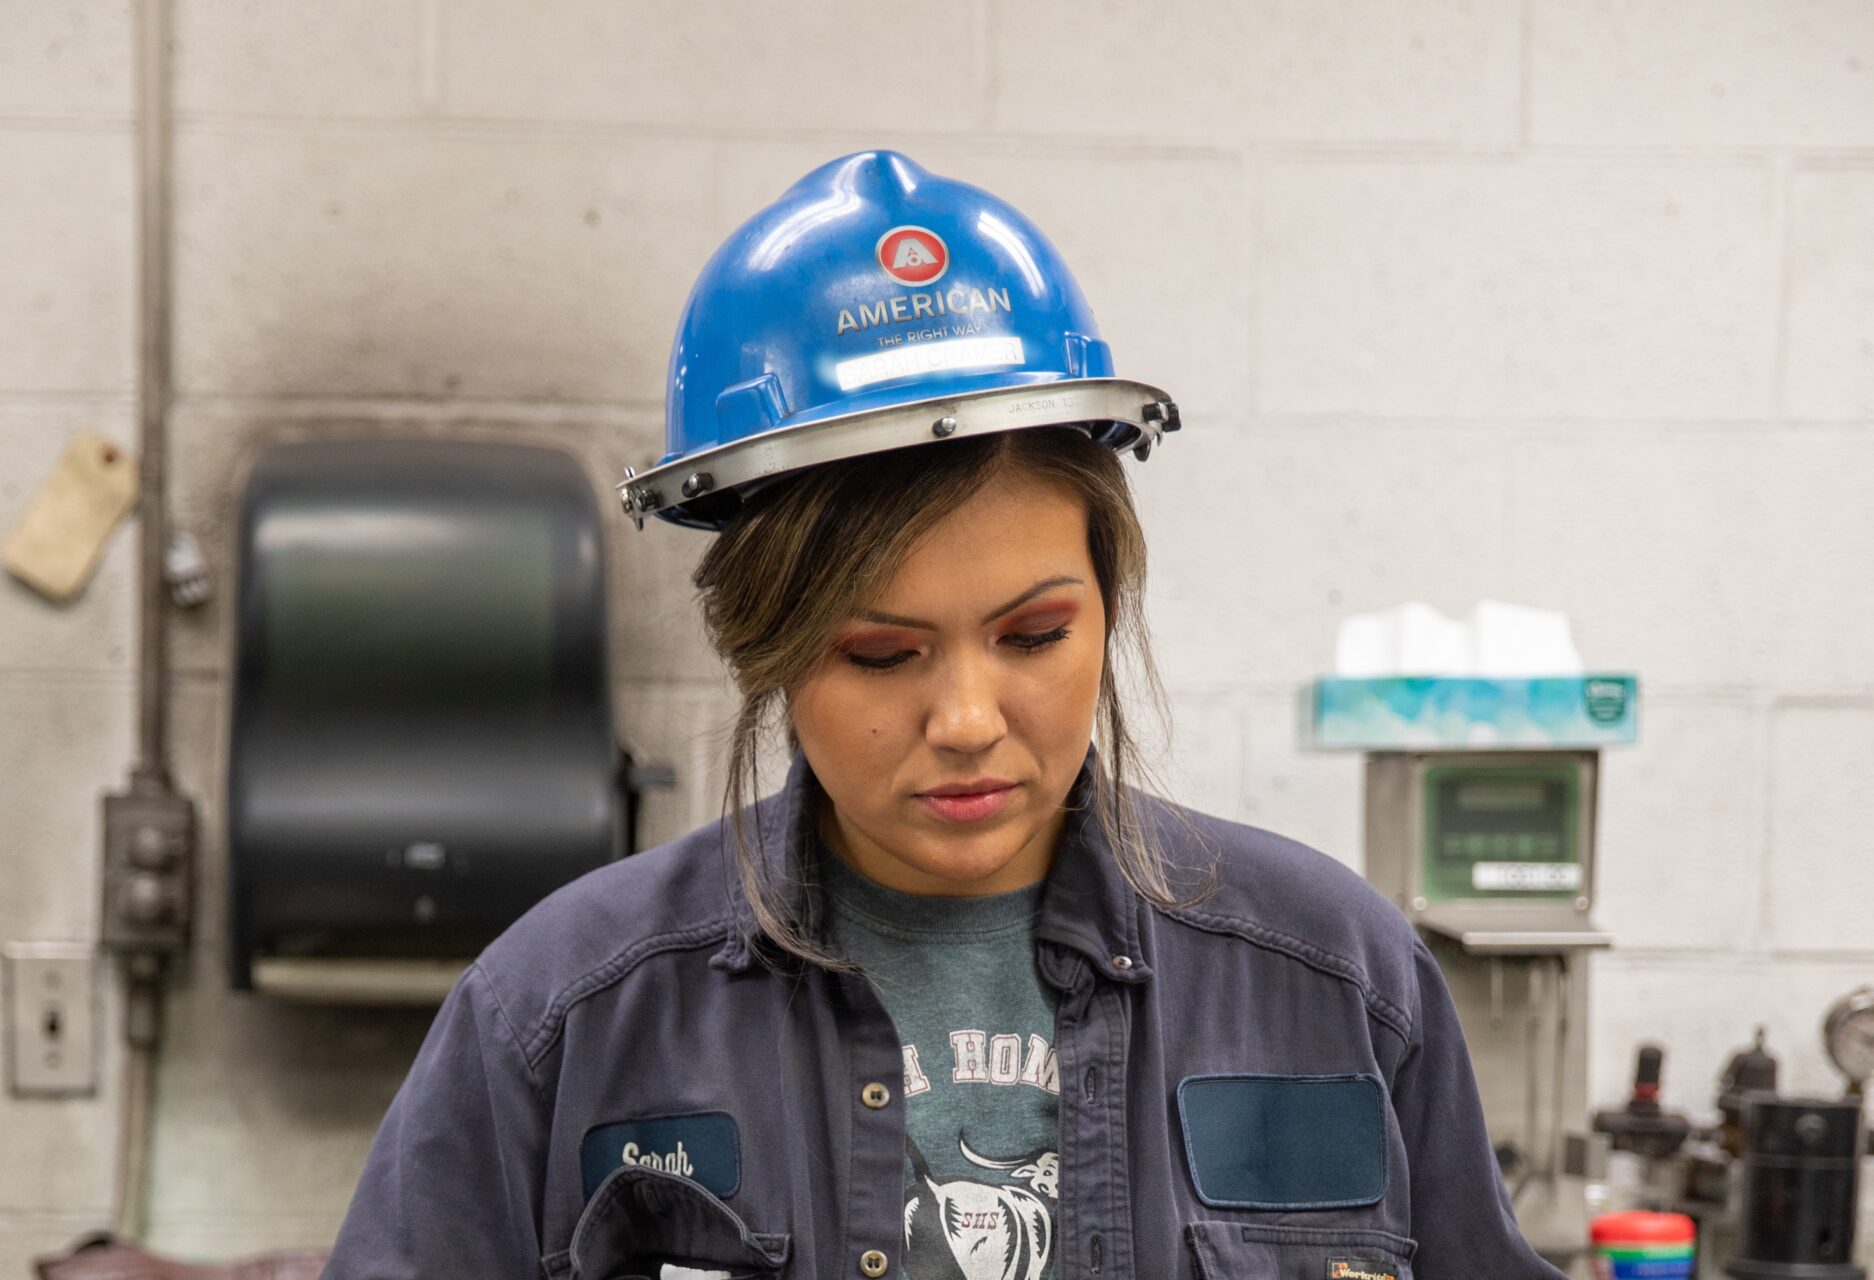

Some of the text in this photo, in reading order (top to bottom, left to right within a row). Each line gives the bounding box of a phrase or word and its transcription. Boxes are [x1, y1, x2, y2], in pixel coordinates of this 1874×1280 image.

[837, 287, 1012, 335] AMERICAN
[906, 326, 948, 343] RIGHT
[951, 322, 982, 337] WAY
[1008, 398, 1056, 414] JACKSON
[961, 1211, 1000, 1230] SHS
